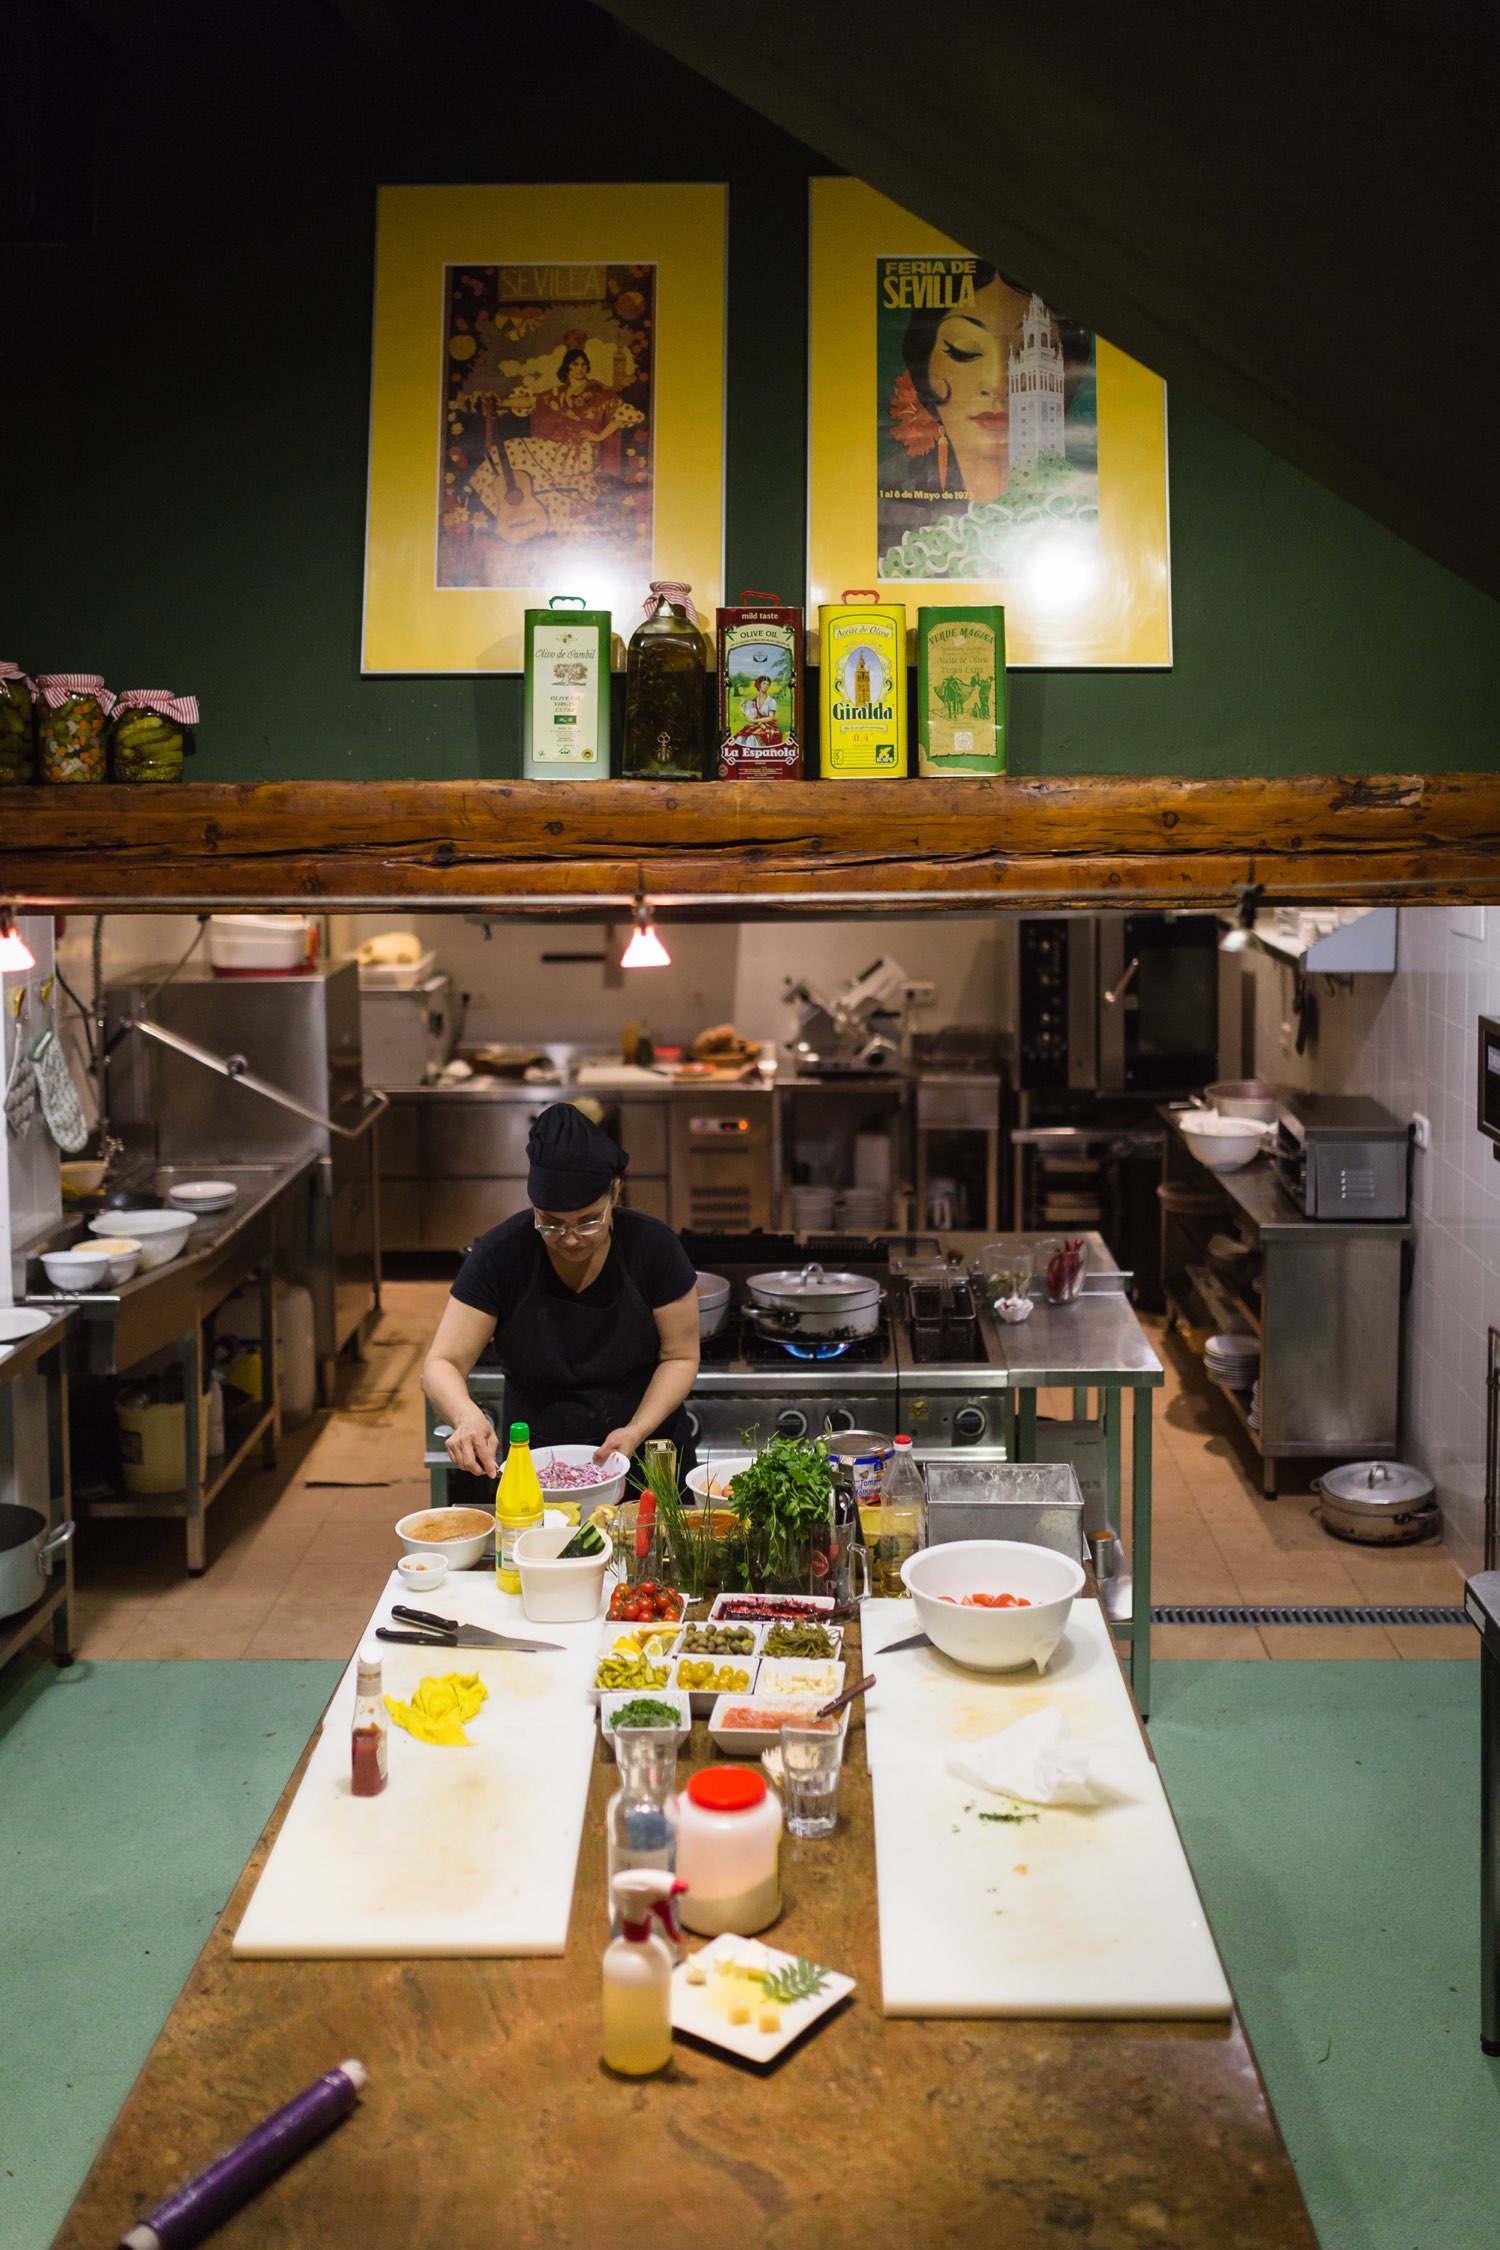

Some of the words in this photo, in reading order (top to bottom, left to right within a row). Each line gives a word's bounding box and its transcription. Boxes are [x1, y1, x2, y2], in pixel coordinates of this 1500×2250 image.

[885, 261, 946, 274] FERIA
[951, 261, 976, 274] DE
[501, 267, 602, 297] SEVILLA
[883, 275, 976, 309] SEVILLA
[895, 490, 901, 498] 6
[902, 490, 912, 498] de
[914, 490, 940, 501] Mayo
[942, 491, 954, 499] de
[740, 630, 763, 639] OLIVE
[765, 630, 779, 639] OIL
[836, 628, 858, 638] Aceite
[860, 625, 867, 633] de
[928, 628, 957, 645] VERDE
[535, 649, 556, 659] Olivo
[557, 649, 566, 659] de
[832, 702, 893, 721] Giralda
[724, 747, 739, 757] La
[742, 747, 796, 759] Española
